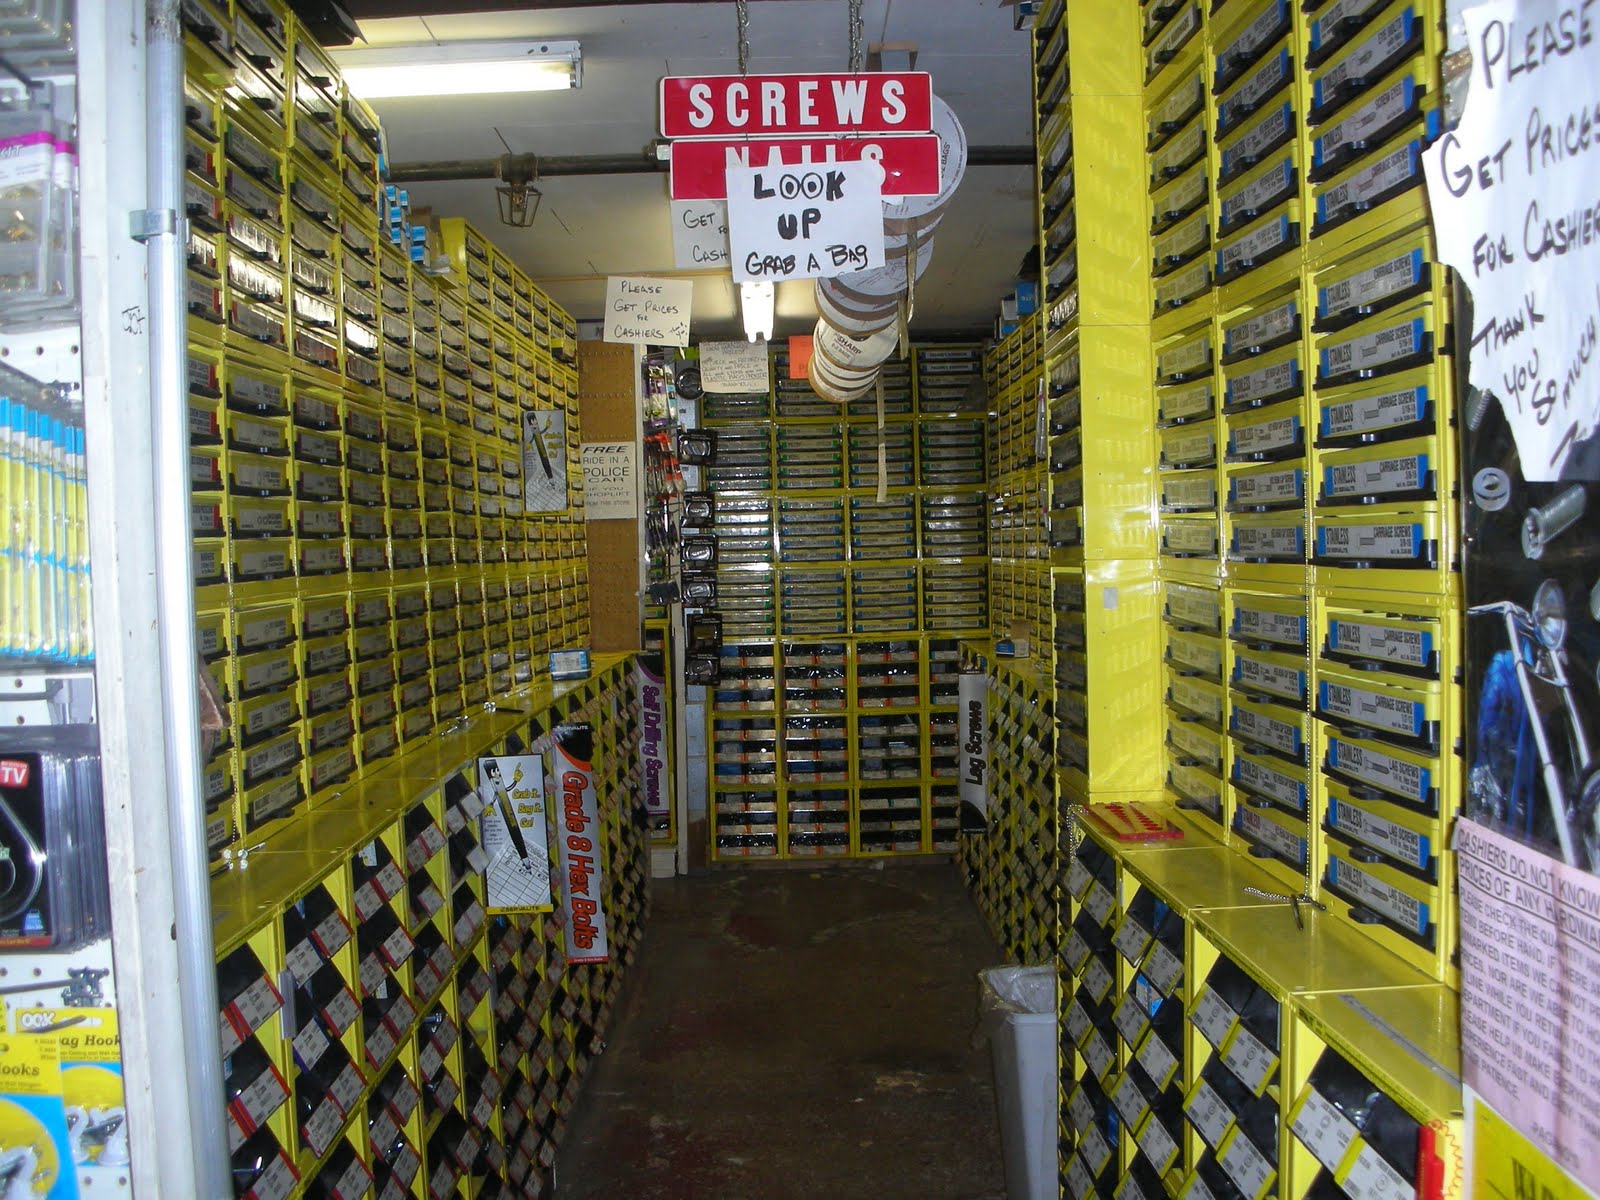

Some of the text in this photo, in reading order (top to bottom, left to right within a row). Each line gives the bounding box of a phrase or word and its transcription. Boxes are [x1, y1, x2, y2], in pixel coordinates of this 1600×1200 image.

[1481, 0, 1596, 90] PLEASE
[688, 79, 907, 129] SCREWS
[1440, 131, 1513, 199] GET
[753, 170, 847, 200] LOOK
[683, 209, 716, 229] GET
[718, 226, 728, 235] FO
[778, 208, 822, 240] UP
[692, 245, 728, 263] CASH
[746, 251, 796, 276] GRAB
[807, 253, 821, 273] A
[1473, 232, 1514, 278] FOR
[621, 280, 663, 294] PLEASE
[613, 298, 679, 315] GET PRICES
[614, 324, 665, 339] CASHIERS
[1471, 291, 1545, 358] THANK
[1503, 348, 1540, 415] YOU
[1398, 390, 1416, 405] SCREWS
[1330, 403, 1354, 425] STAINLESS
[583, 446, 628, 454] FREE
[583, 455, 631, 465] RIDE IN A
[584, 466, 631, 477] POLICE
[1333, 465, 1356, 485] STAINLESS
[1400, 457, 1417, 471] SCREWS
[1326, 526, 1349, 545] STAINLESS
[1393, 525, 1412, 538] SCREWS
[1338, 624, 1361, 643] STAINLESS
[1403, 631, 1421, 644] SCREWS
[642, 685, 661, 711] Self
[1328, 684, 1351, 706] STAINLESS
[1395, 698, 1413, 714] SCREWS
[641, 711, 662, 757] Drilling
[964, 700, 987, 785] Lag Screws
[1337, 741, 1362, 767] STAINLESS
[2, 767, 28, 784] TV
[1389, 758, 1419, 780] LAG SCREWS
[512, 788, 531, 799] Grab
[645, 758, 663, 807] Screws
[517, 803, 533, 815] Bag
[562, 771, 591, 833] Grade
[1337, 801, 1362, 829] STAINLESS
[566, 835, 592, 852] 8
[1388, 823, 1419, 846] LAG SCREWS
[1459, 827, 1506, 870] CASHIERS
[1509, 853, 1526, 879] DO
[1530, 863, 1554, 893] NOT
[567, 853, 595, 896] Hex
[1459, 855, 1491, 891] PRICES
[1494, 875, 1510, 901] OF
[1515, 884, 1539, 914] ANY
[571, 897, 599, 950] Bolts
[1485, 902, 1516, 932] CHECK
[1520, 917, 1537, 940] THE
[1479, 916, 1514, 951] BEFORE
[1548, 953, 1555, 971] IF
[1502, 950, 1529, 979] ITEMS
[1533, 967, 1546, 988] WE
[1488, 962, 1507, 987] NOR
[1511, 975, 1527, 998] ARE
[1529, 985, 1544, 1009] WE
[1571, 1013, 1584, 1036] TO
[1463, 985, 1510, 1032] EPARTMENT
[1523, 1025, 1539, 1050] YOU
[1486, 980, 1511, 1010] WHILE
[1515, 999, 1532, 1024] YOU
[1573, 1038, 1584, 1059] TO
[60, 1036, 79, 1049] ag
[1489, 1023, 1509, 1051] HELP
[1525, 1048, 1550, 1080] MAKE
[0, 1063, 41, 1077] ooks
[1529, 1074, 1548, 1102] AND
